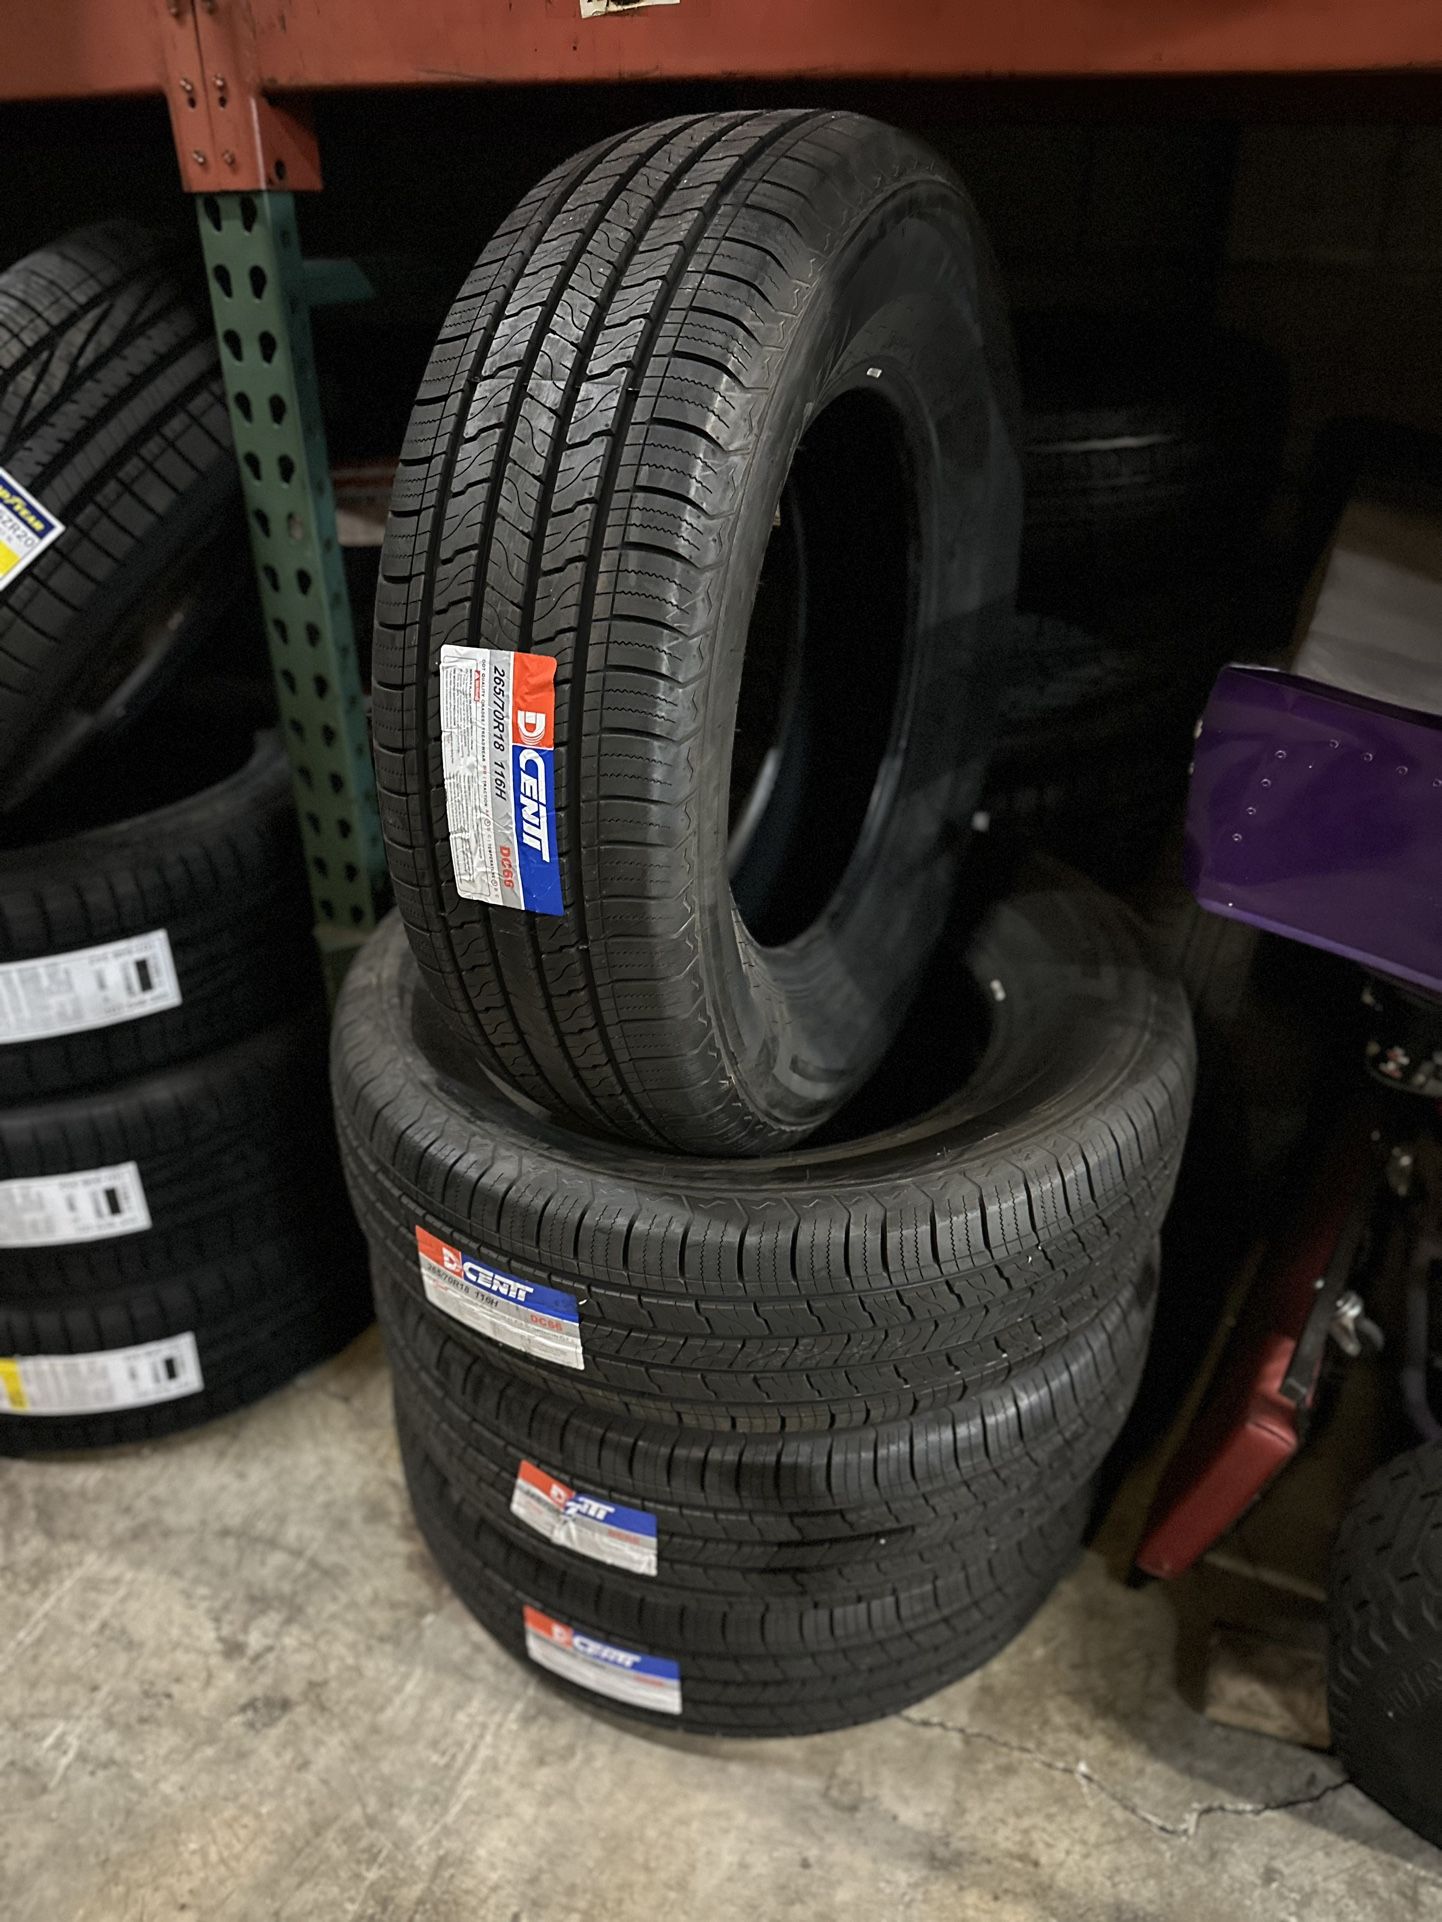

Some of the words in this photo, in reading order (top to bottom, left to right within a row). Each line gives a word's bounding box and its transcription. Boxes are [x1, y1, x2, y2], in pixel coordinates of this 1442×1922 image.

[493, 666, 506, 752] 265/70R18
[494, 761, 507, 801] 116H
[500, 845, 515, 890] DC66
[474, 1290, 499, 1308] 116H
